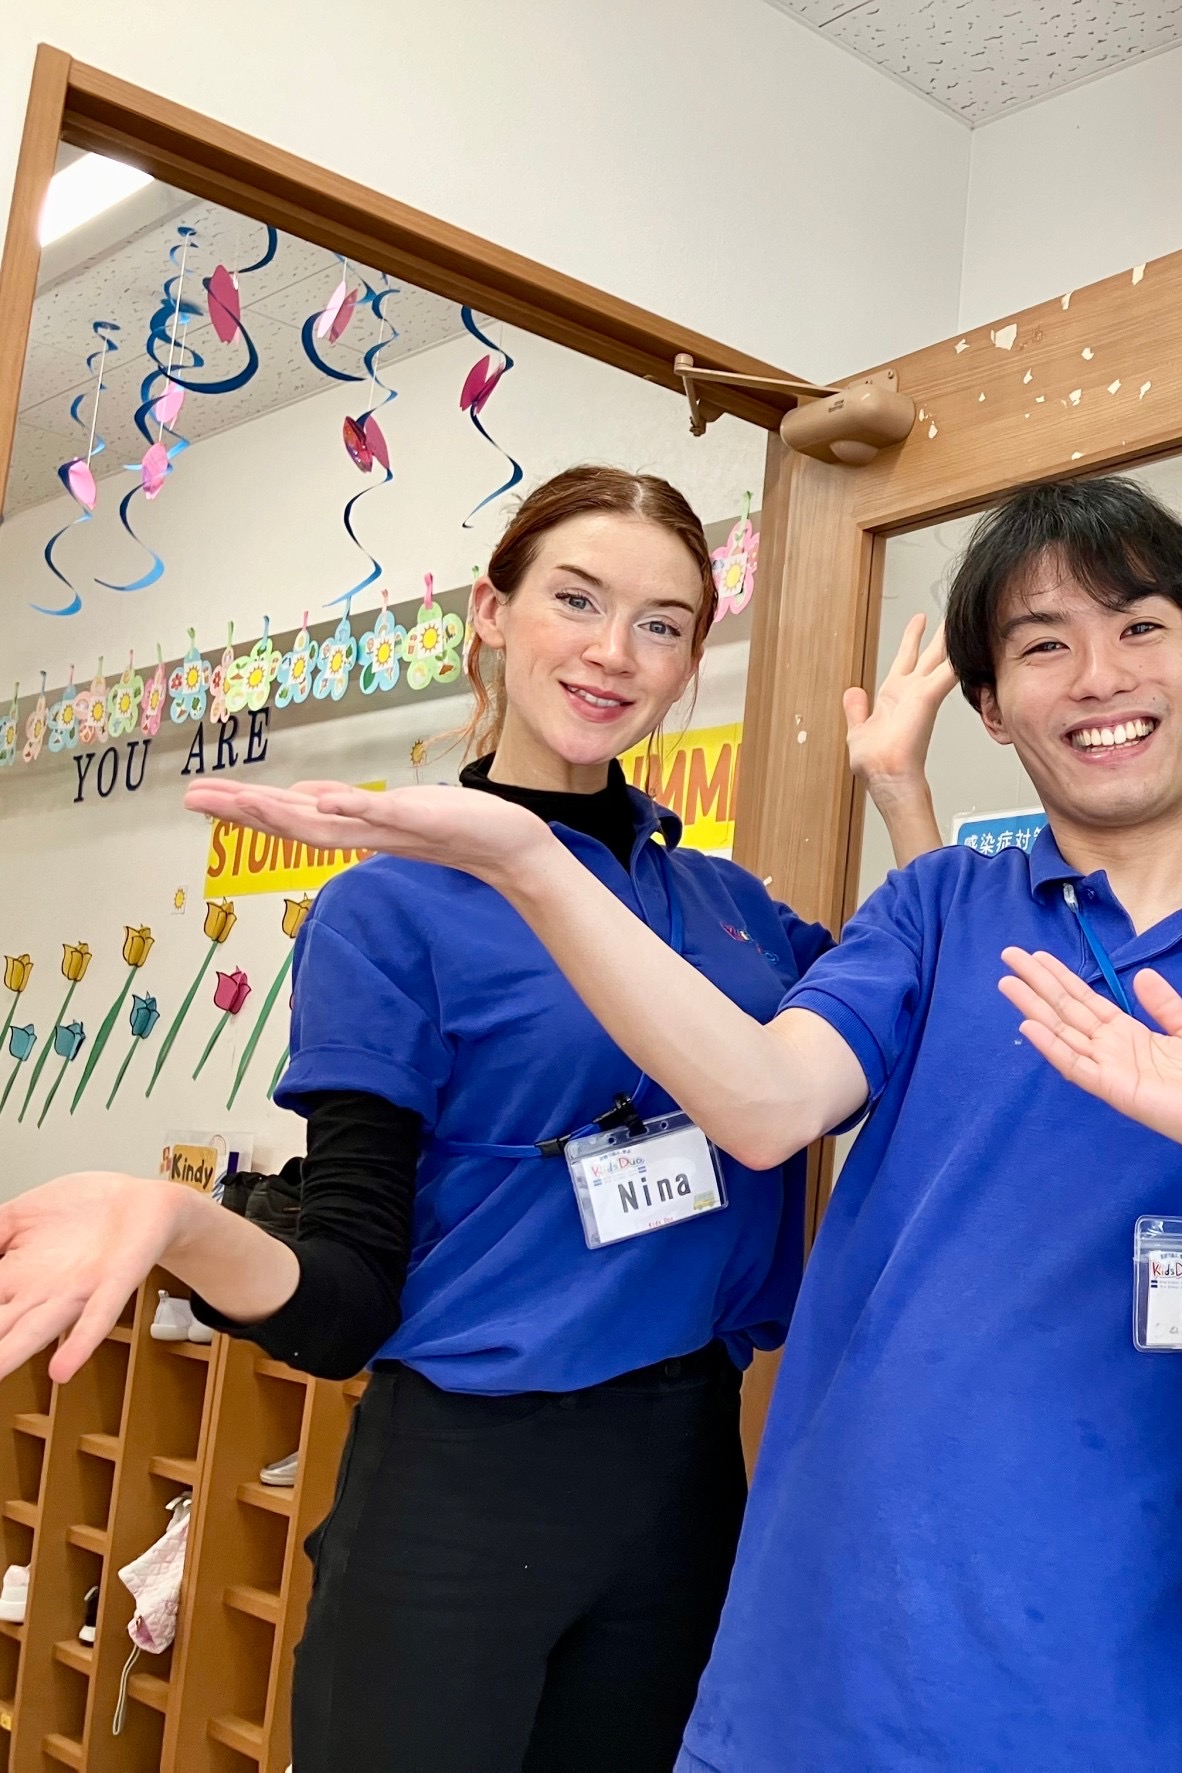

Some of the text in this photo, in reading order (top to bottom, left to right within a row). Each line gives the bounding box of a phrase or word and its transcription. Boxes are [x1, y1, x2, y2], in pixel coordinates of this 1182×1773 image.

[72, 706, 270, 803] YOU ARE
[171, 1153, 214, 1190] Kindy
[617, 1173, 692, 1214] Nina
